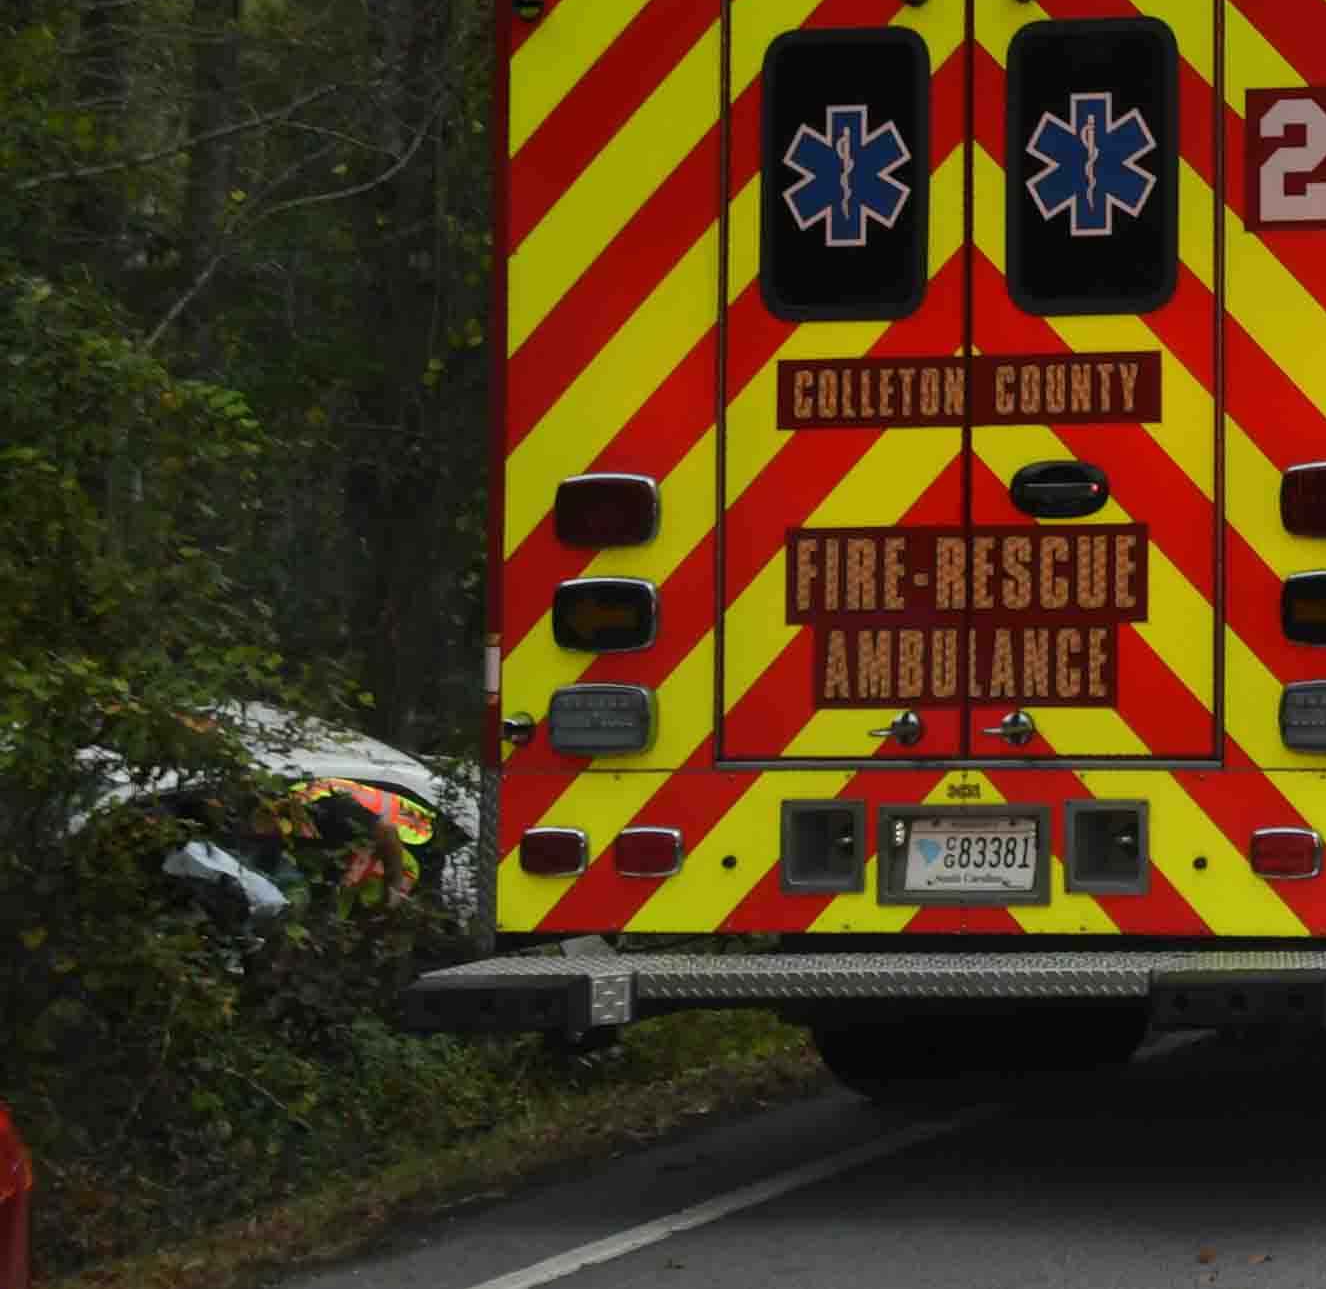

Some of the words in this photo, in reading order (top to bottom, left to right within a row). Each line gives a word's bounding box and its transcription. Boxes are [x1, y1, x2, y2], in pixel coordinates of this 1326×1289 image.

[792, 366, 966, 419] COLLETON
[994, 362, 1140, 414] COUNTY
[797, 533, 1137, 611] FIRE-RESCUE
[822, 626, 1108, 699] AMBULANCE
